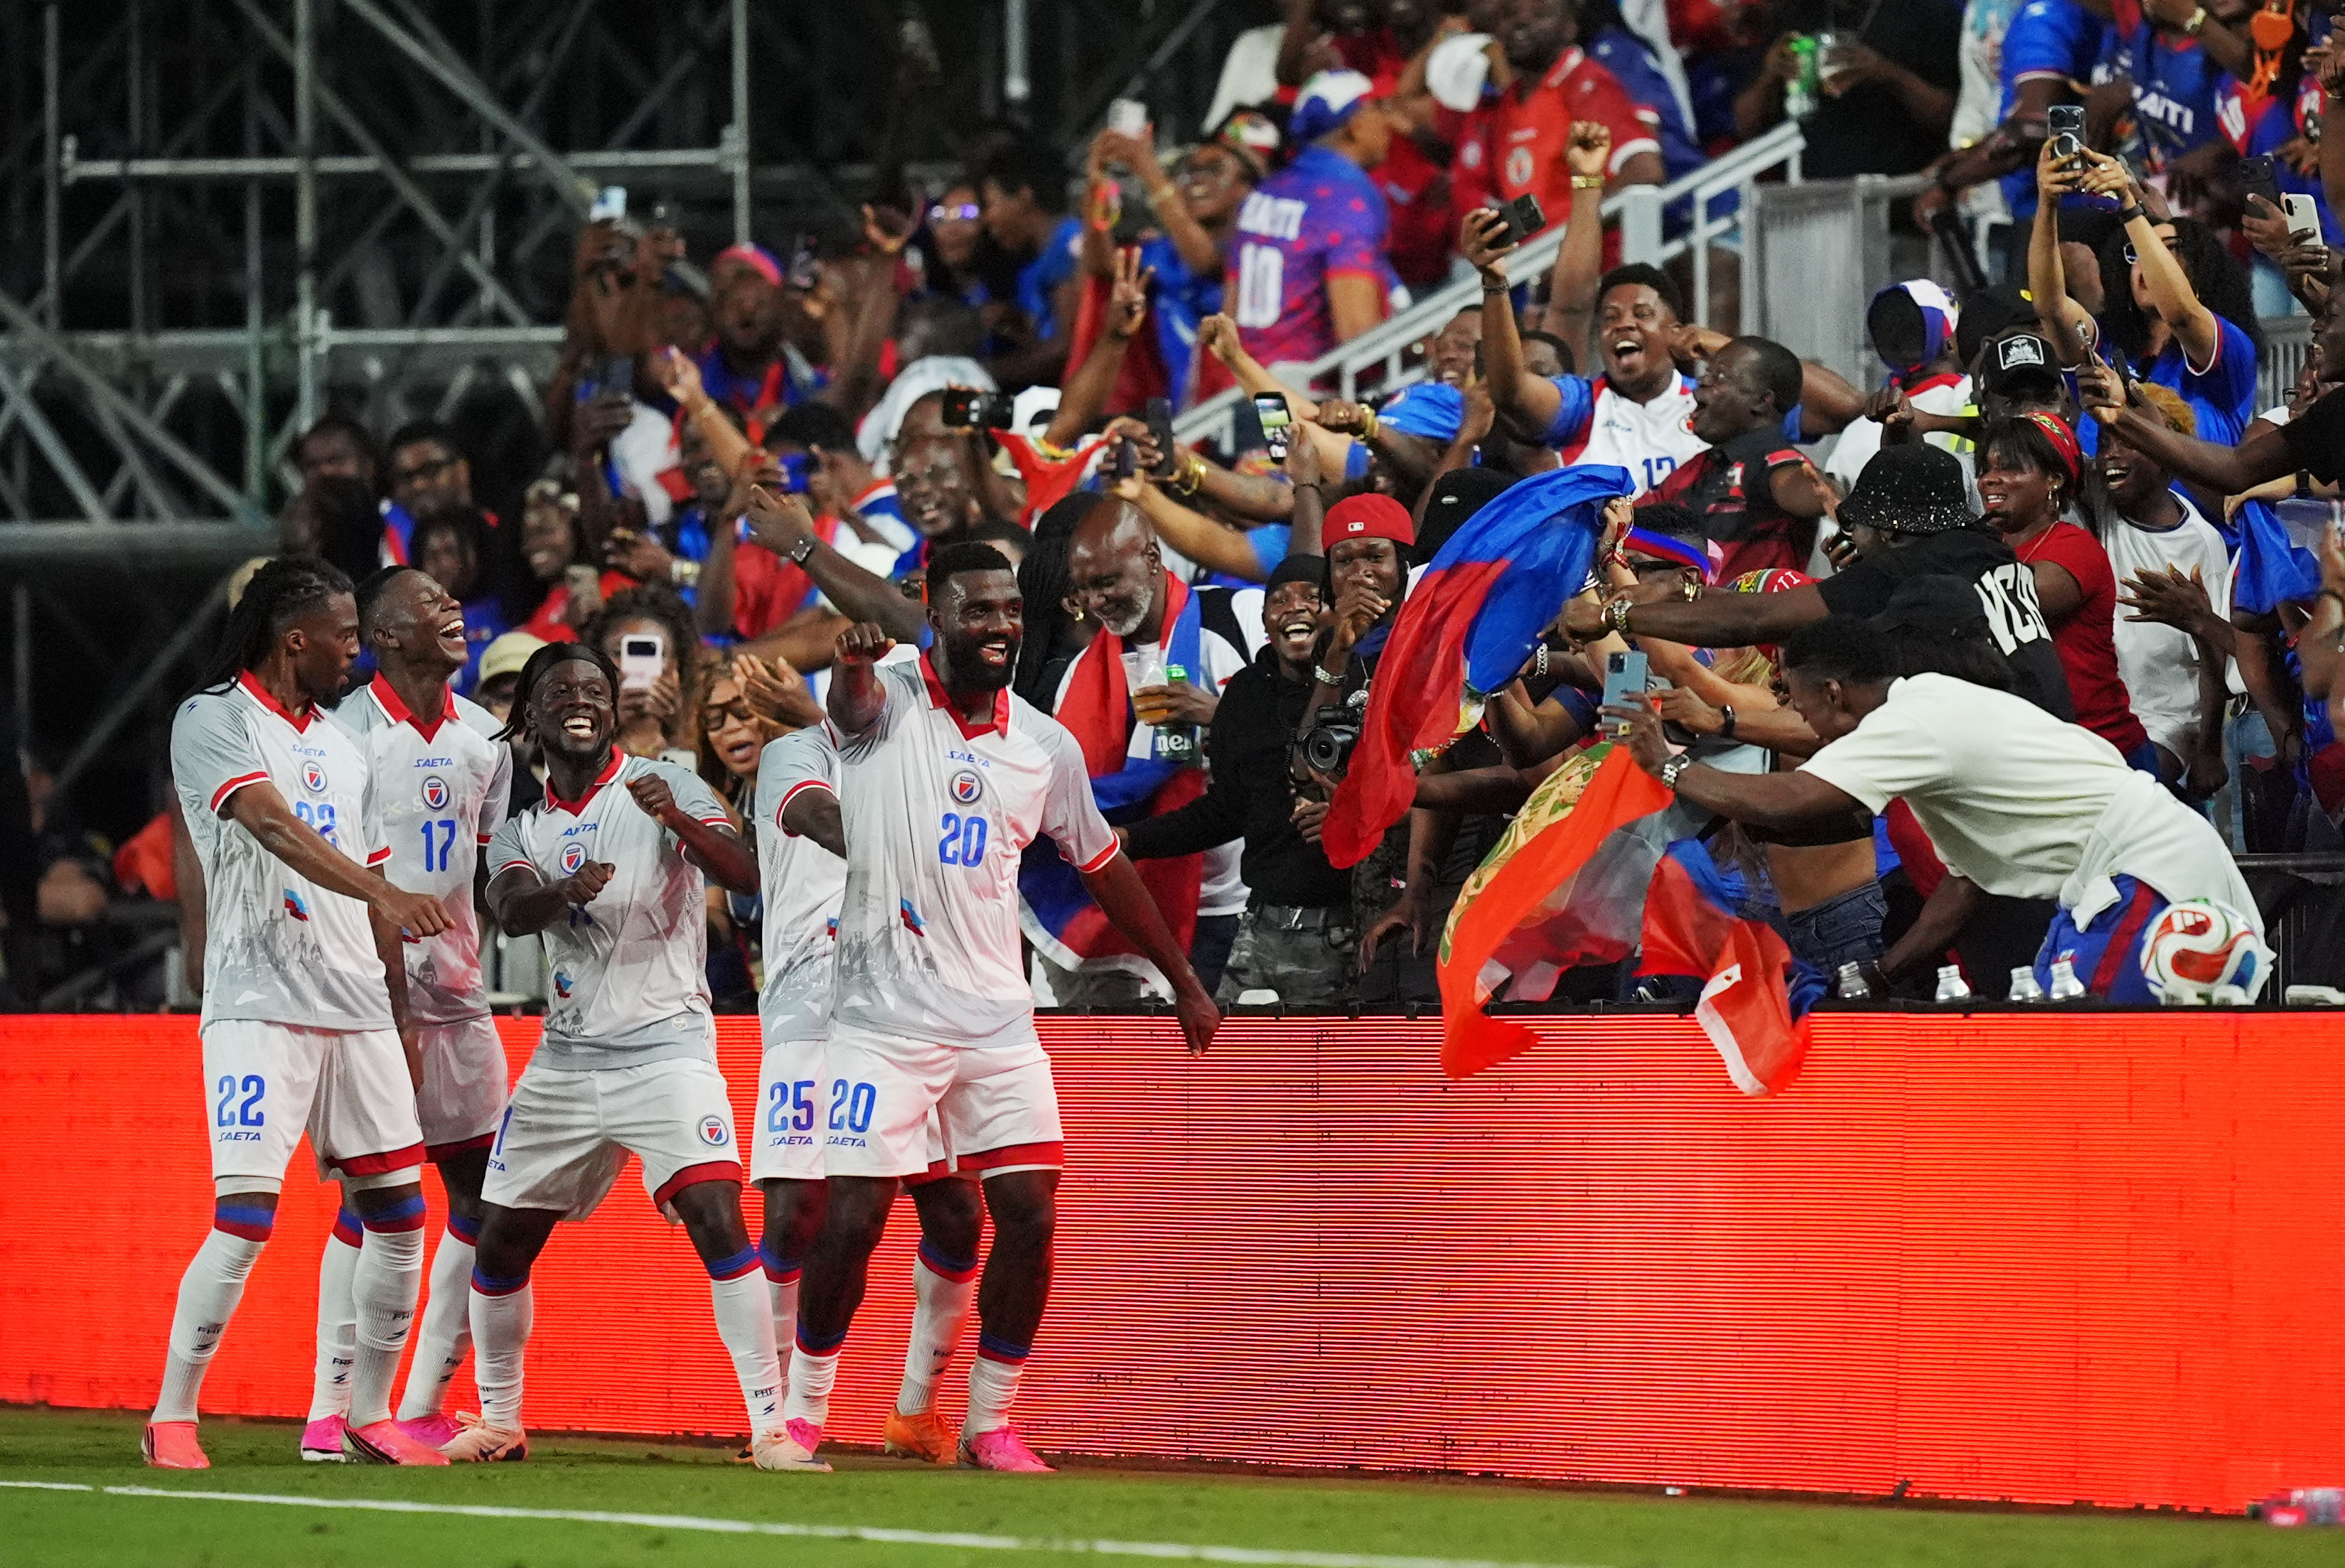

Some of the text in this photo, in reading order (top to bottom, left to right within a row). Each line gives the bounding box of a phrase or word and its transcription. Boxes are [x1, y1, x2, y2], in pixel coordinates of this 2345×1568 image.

[291, 744, 326, 757] SAETA
[414, 757, 454, 768] SAETA
[945, 751, 990, 768] SAETA
[421, 820, 456, 872] 17
[939, 812, 987, 867] 20
[218, 1075, 265, 1127] 22
[768, 1080, 815, 1133] 25
[828, 1079, 876, 1133] 20
[218, 1132, 261, 1142] SAETA
[769, 1136, 813, 1147] SAETA
[826, 1136, 866, 1147] SAETA
[754, 1387, 776, 1398] FHF
